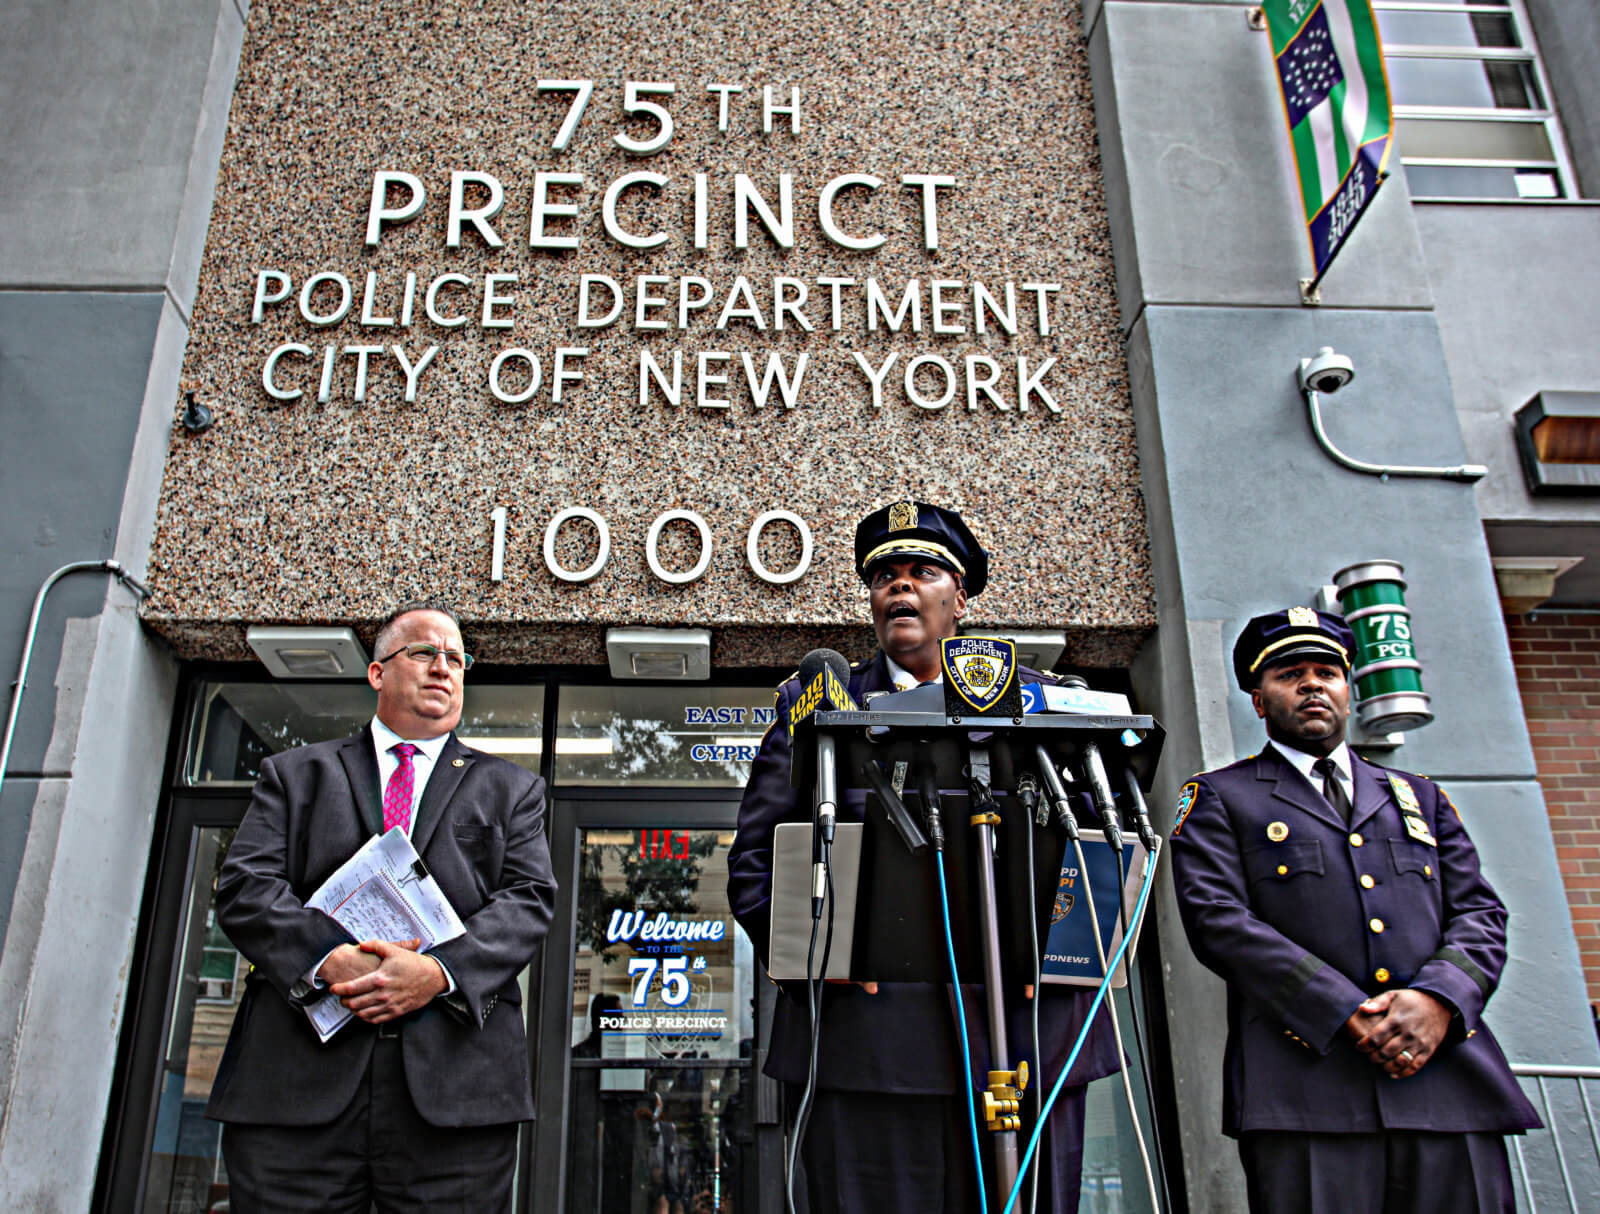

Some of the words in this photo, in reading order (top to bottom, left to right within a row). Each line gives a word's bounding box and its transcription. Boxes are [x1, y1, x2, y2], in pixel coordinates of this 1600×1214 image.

[364, 170, 957, 252] PRECINCT
[251, 269, 519, 330] POLICE
[576, 272, 1063, 338] DEPARTMENT
[261, 343, 441, 403] CITY
[488, 347, 585, 405] OF
[638, 350, 810, 410] NEW
[851, 352, 1062, 414] YORK
[490, 505, 814, 585] 1000
[1368, 614, 1411, 641] 75
[949, 646, 1008, 660] DEPARTMENT
[961, 639, 994, 649] POLICE
[1377, 644, 1412, 658] PCT
[949, 665, 964, 685] CITY
[961, 685, 973, 697] OF
[983, 686, 1000, 702] NEW
[997, 665, 1010, 686] YORK
[789, 671, 824, 723] 1010
[685, 707, 747, 725] EAST
[1060, 867, 1079, 878] PD
[1059, 877, 1075, 888] PI
[607, 908, 726, 943] Welcome
[646, 945, 661, 954] TO
[663, 944, 685, 954] THE
[1043, 953, 1091, 964] PDNEWS
[599, 1016, 652, 1029] POLICE
[655, 1016, 728, 1029] PRECINCT
